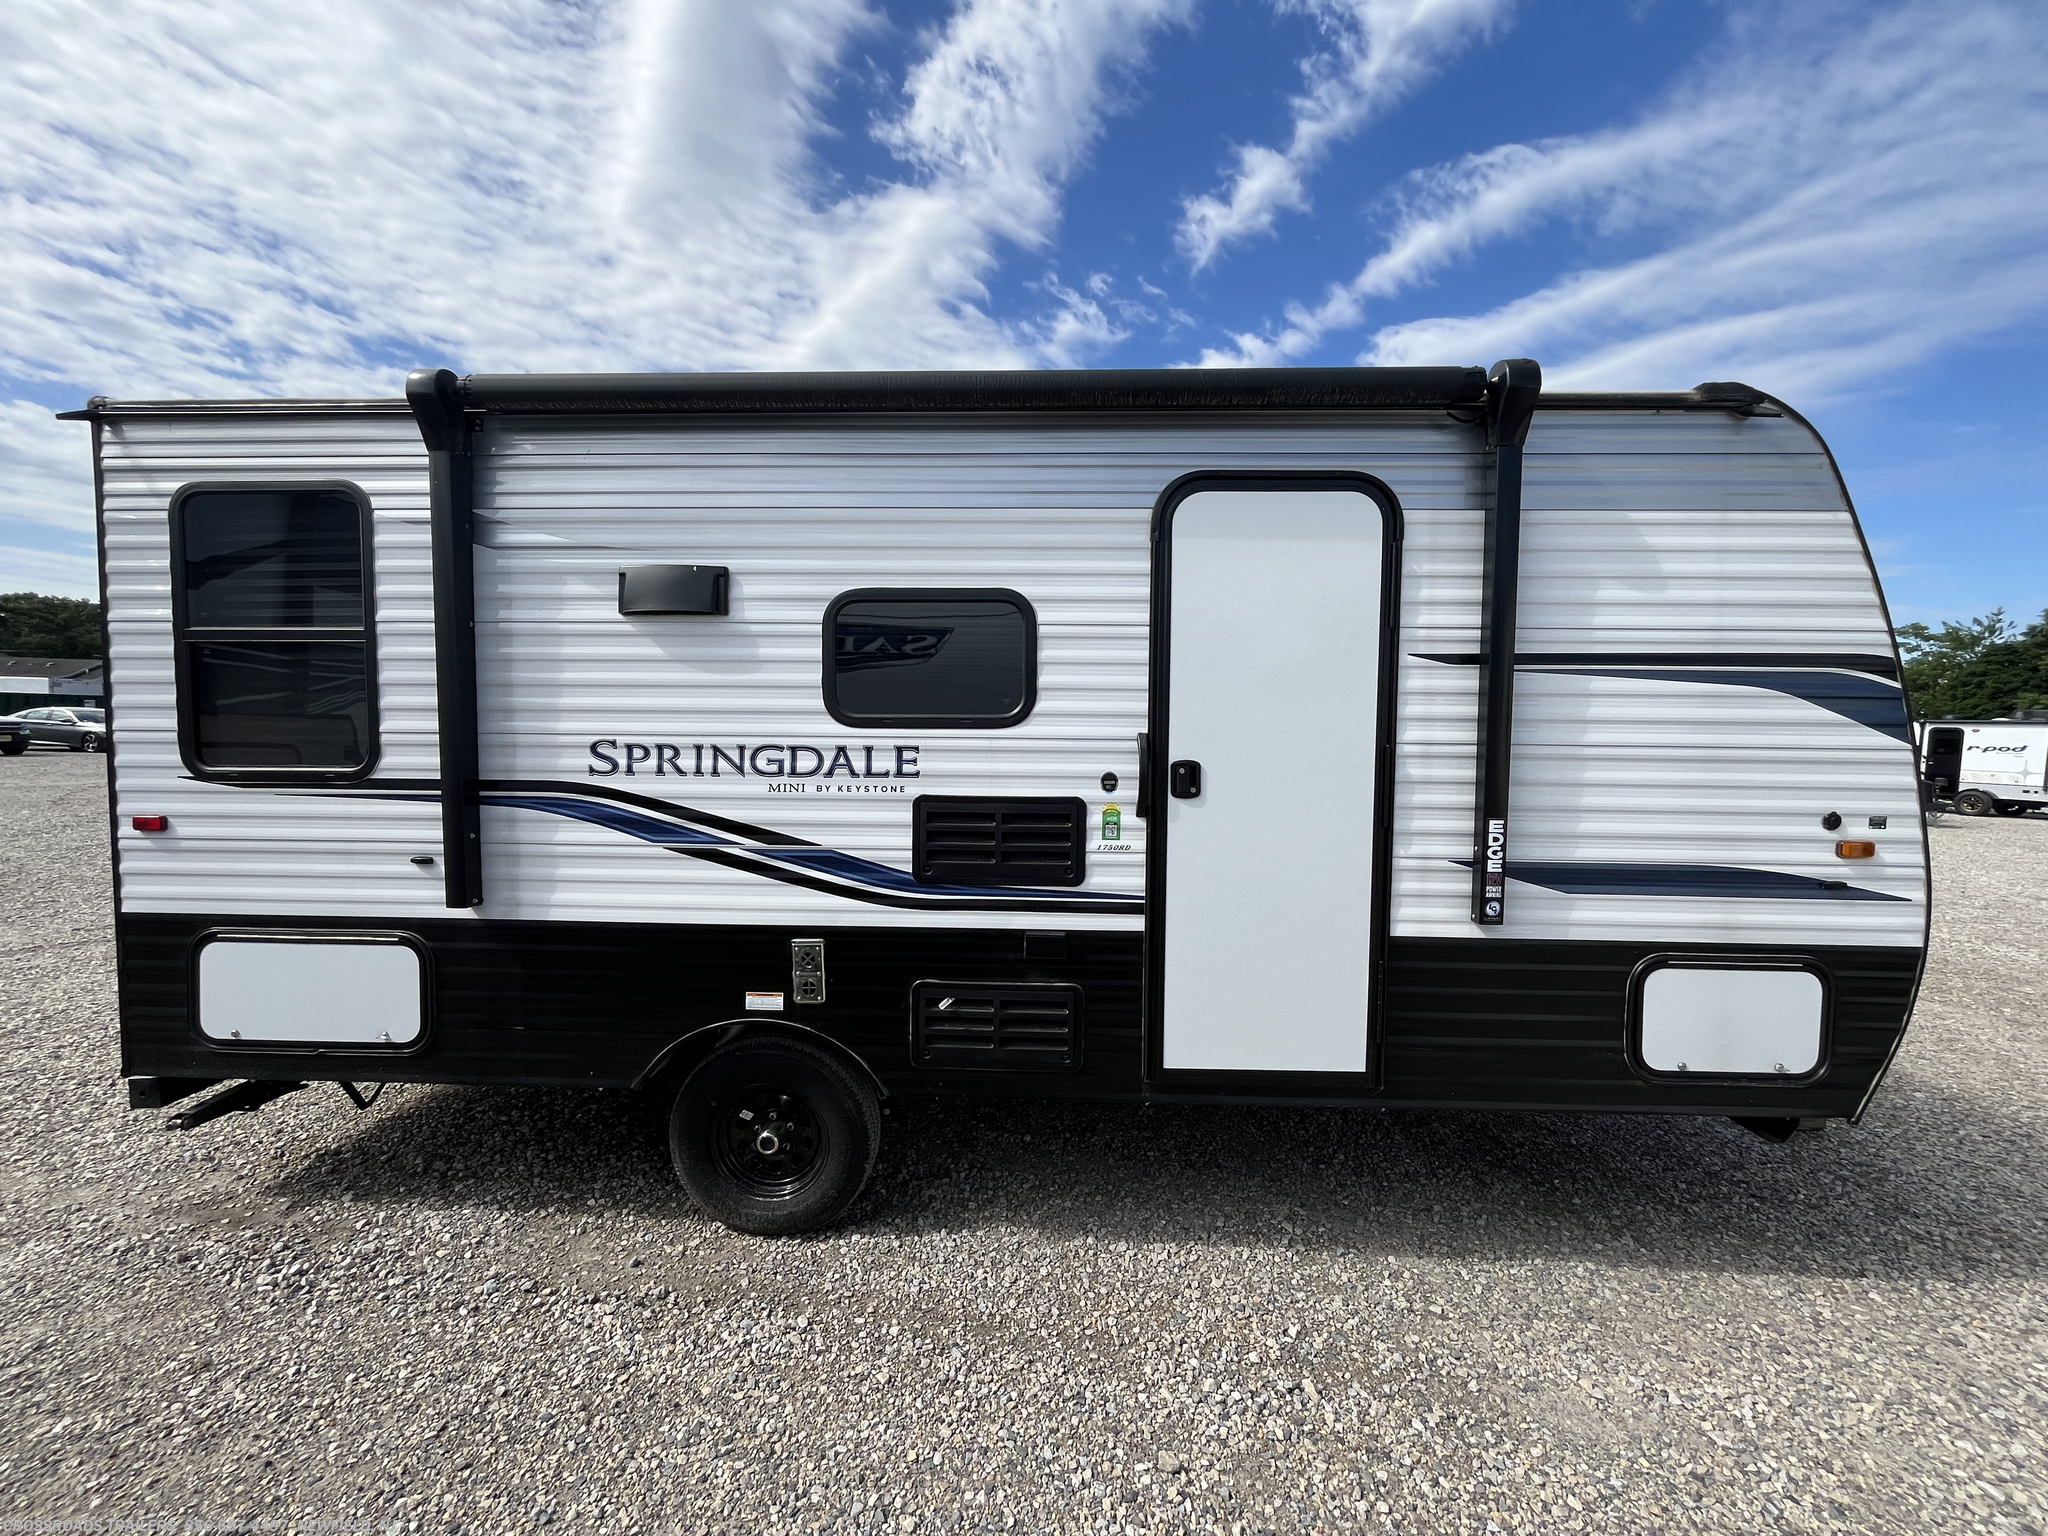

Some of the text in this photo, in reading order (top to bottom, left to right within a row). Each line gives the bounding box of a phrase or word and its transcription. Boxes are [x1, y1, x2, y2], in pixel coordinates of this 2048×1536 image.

[588, 738, 921, 779] SPRINGDALE
[768, 783, 906, 793] MINI BY KEYSTONE
[1487, 820, 1505, 872] EDGE
